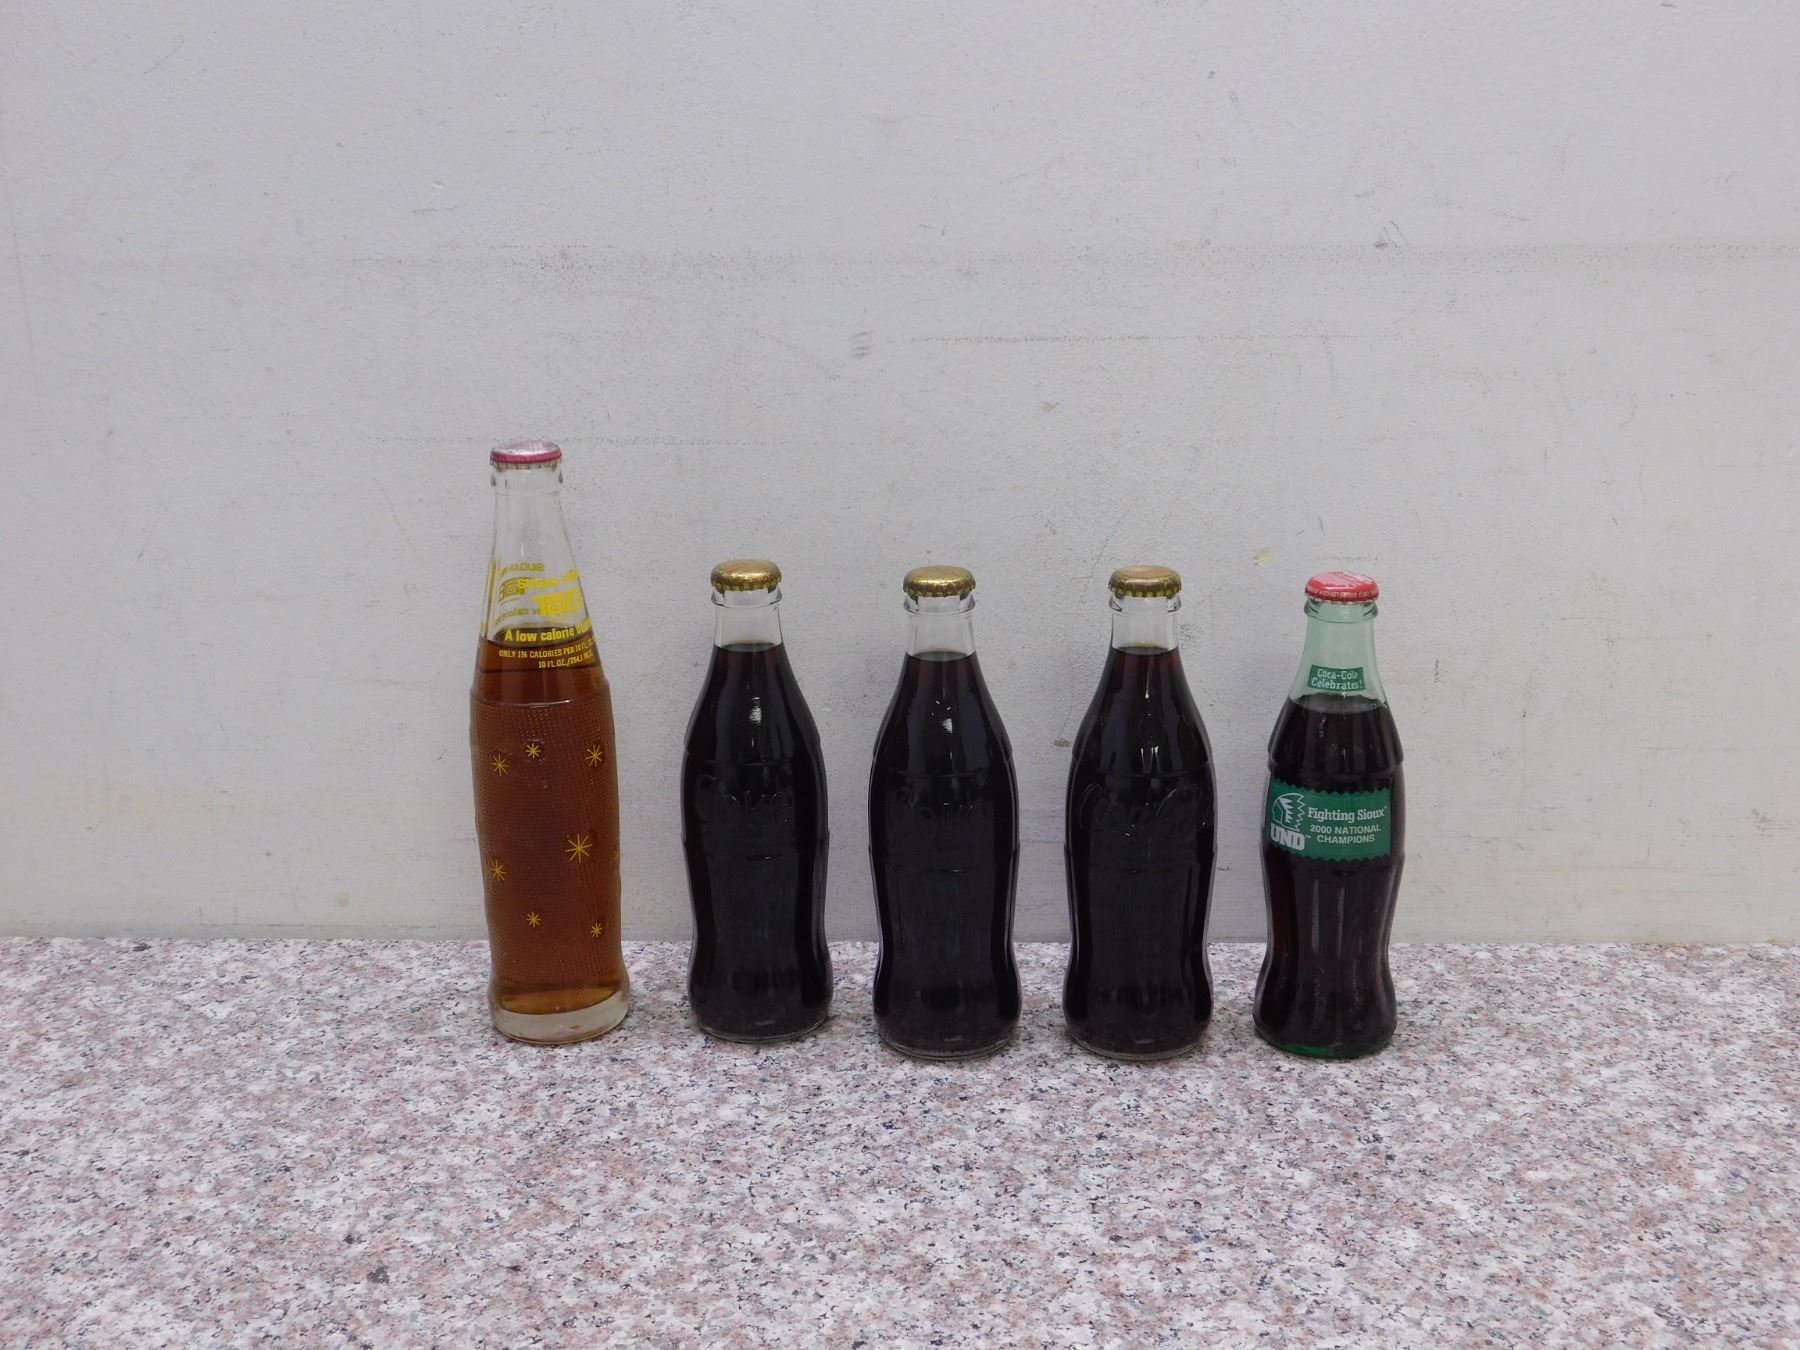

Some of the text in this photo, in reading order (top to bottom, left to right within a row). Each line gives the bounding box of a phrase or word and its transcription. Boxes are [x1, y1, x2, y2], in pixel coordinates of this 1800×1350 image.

[504, 627, 575, 642] A low calorie
[529, 649, 562, 659] CALORIES
[1317, 668, 1359, 680] Coca-Cola
[1311, 677, 1363, 690] Celebrates!
[1307, 807, 1385, 823] Fighting Sioux
[1310, 824, 1381, 835] 2000 NATIONAL
[1270, 822, 1305, 851] UND
[1317, 834, 1375, 845] CHAMPIONS
